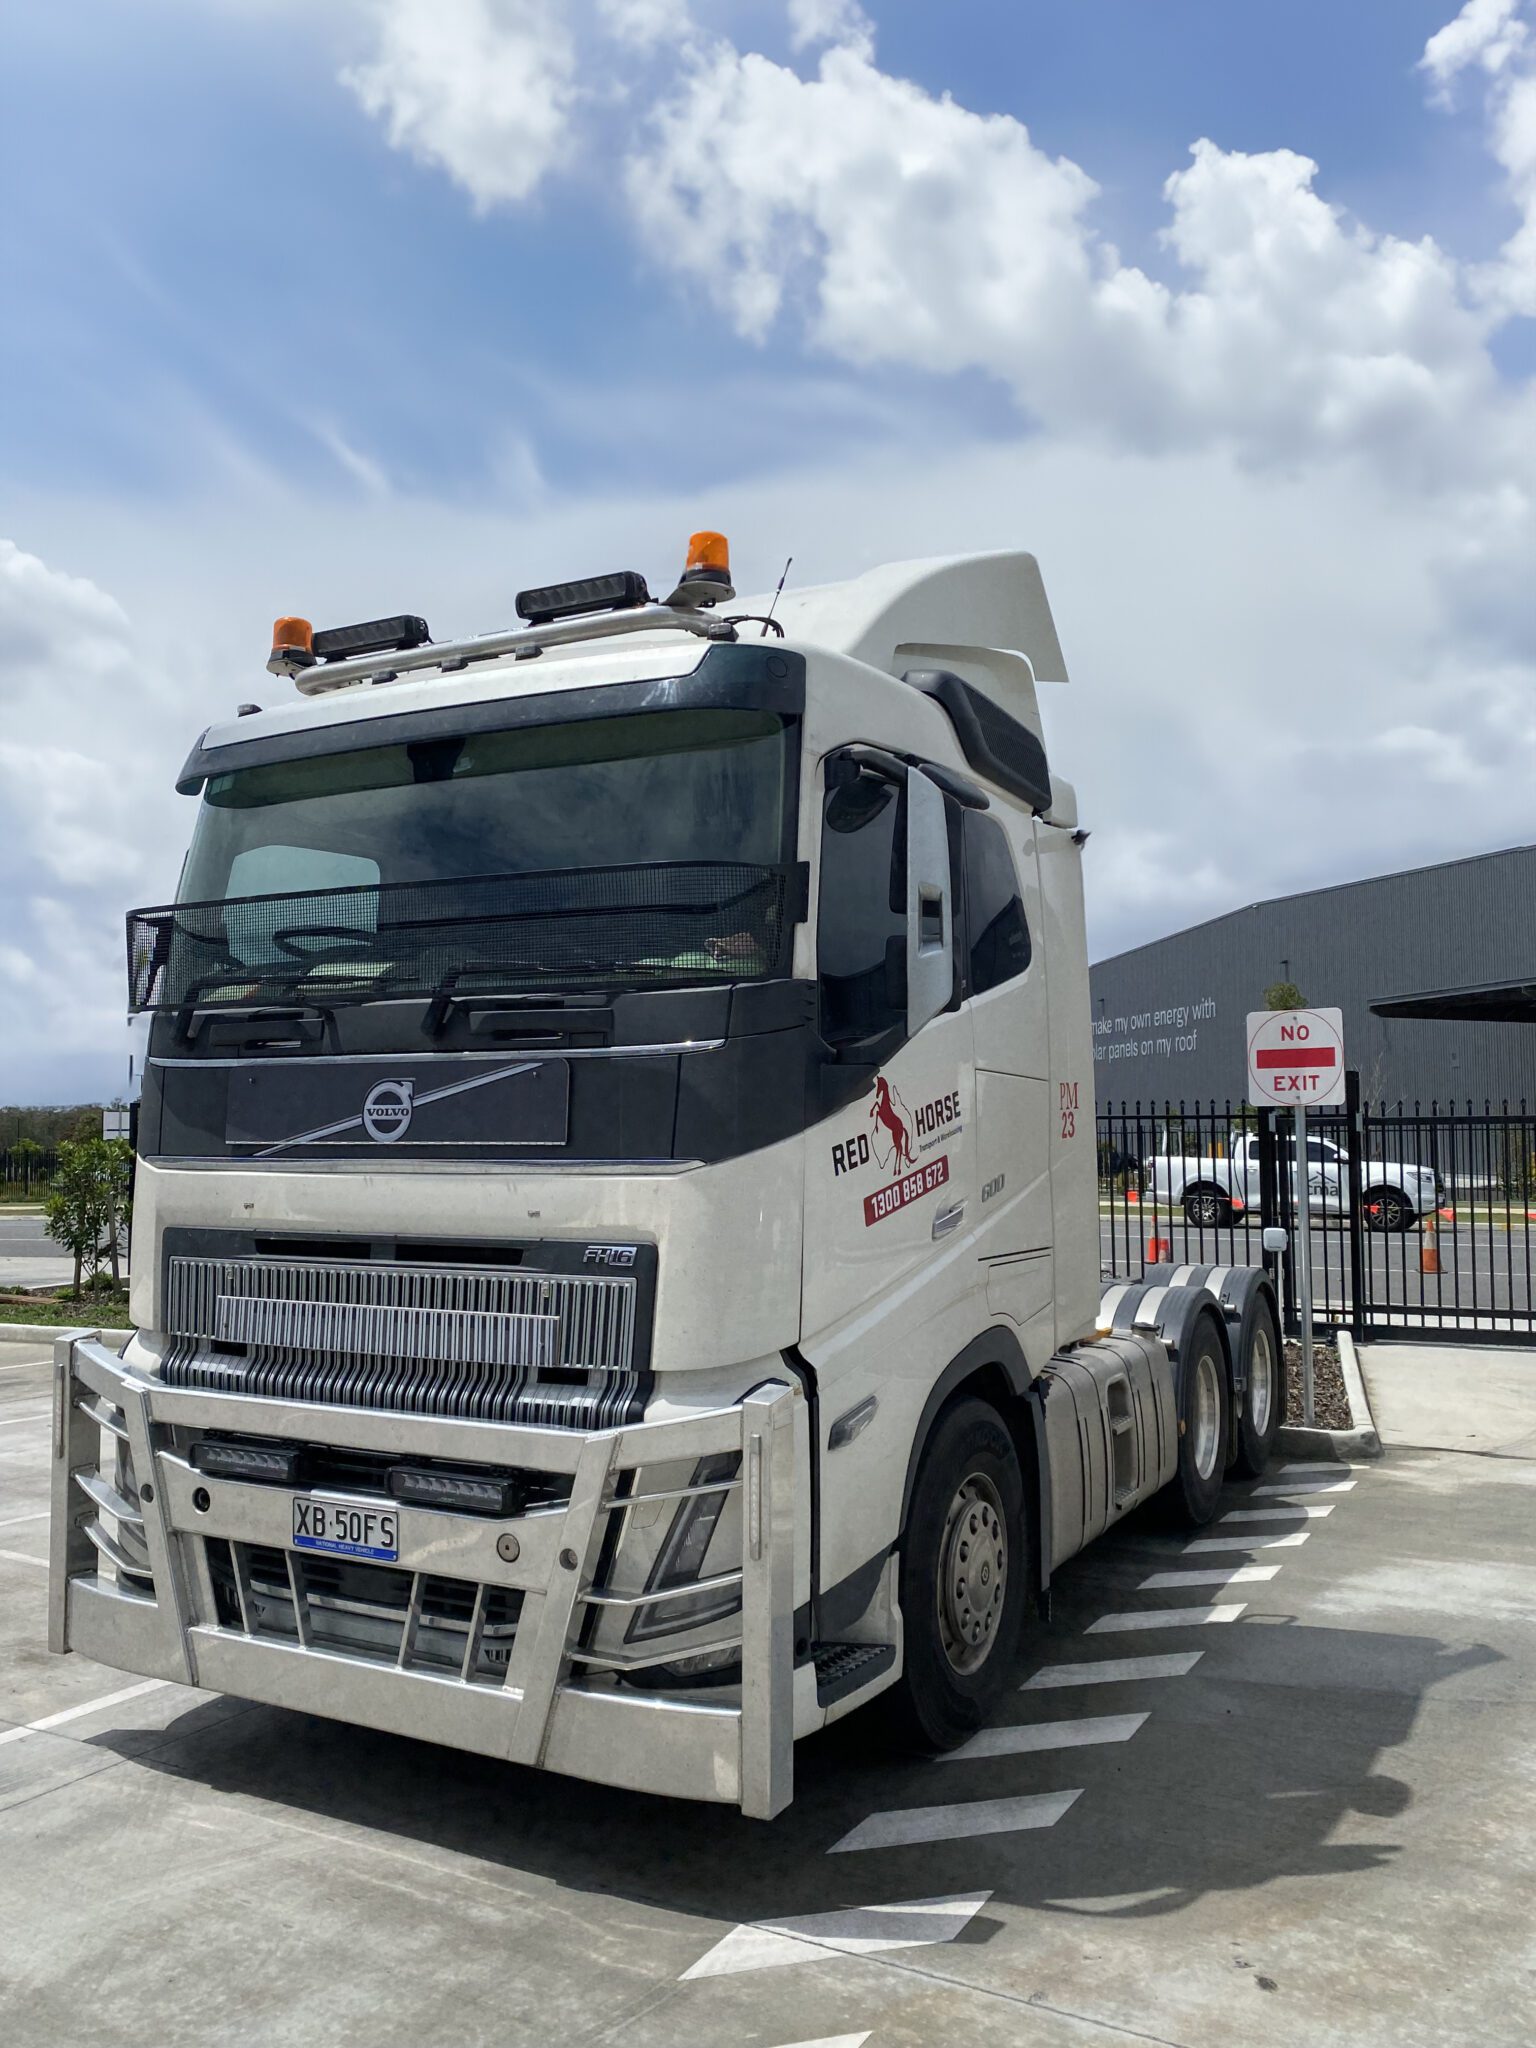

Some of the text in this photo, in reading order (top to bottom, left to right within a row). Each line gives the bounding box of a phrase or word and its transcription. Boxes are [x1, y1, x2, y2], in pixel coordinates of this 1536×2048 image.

[1115, 1016, 1128, 1035] my
[1131, 1012, 1151, 1030] own
[1154, 1005, 1189, 1028] energy
[1192, 996, 1216, 1020] with
[1108, 1038, 1138, 1063] panels
[1141, 1040, 1154, 1055] on
[1156, 1037, 1171, 1058] my
[1175, 1028, 1197, 1052] roof
[1281, 1025, 1310, 1041] NO
[1060, 1082, 1079, 1110] PM
[1273, 1075, 1320, 1091] EXIT
[366, 1108, 410, 1117] VOLVO
[1062, 1111, 1075, 1139] 23
[832, 1090, 961, 1176] RED HORSE
[871, 1161, 944, 1219] 1300 858 672
[981, 1173, 1006, 1203] 600
[582, 1247, 636, 1264] FH16
